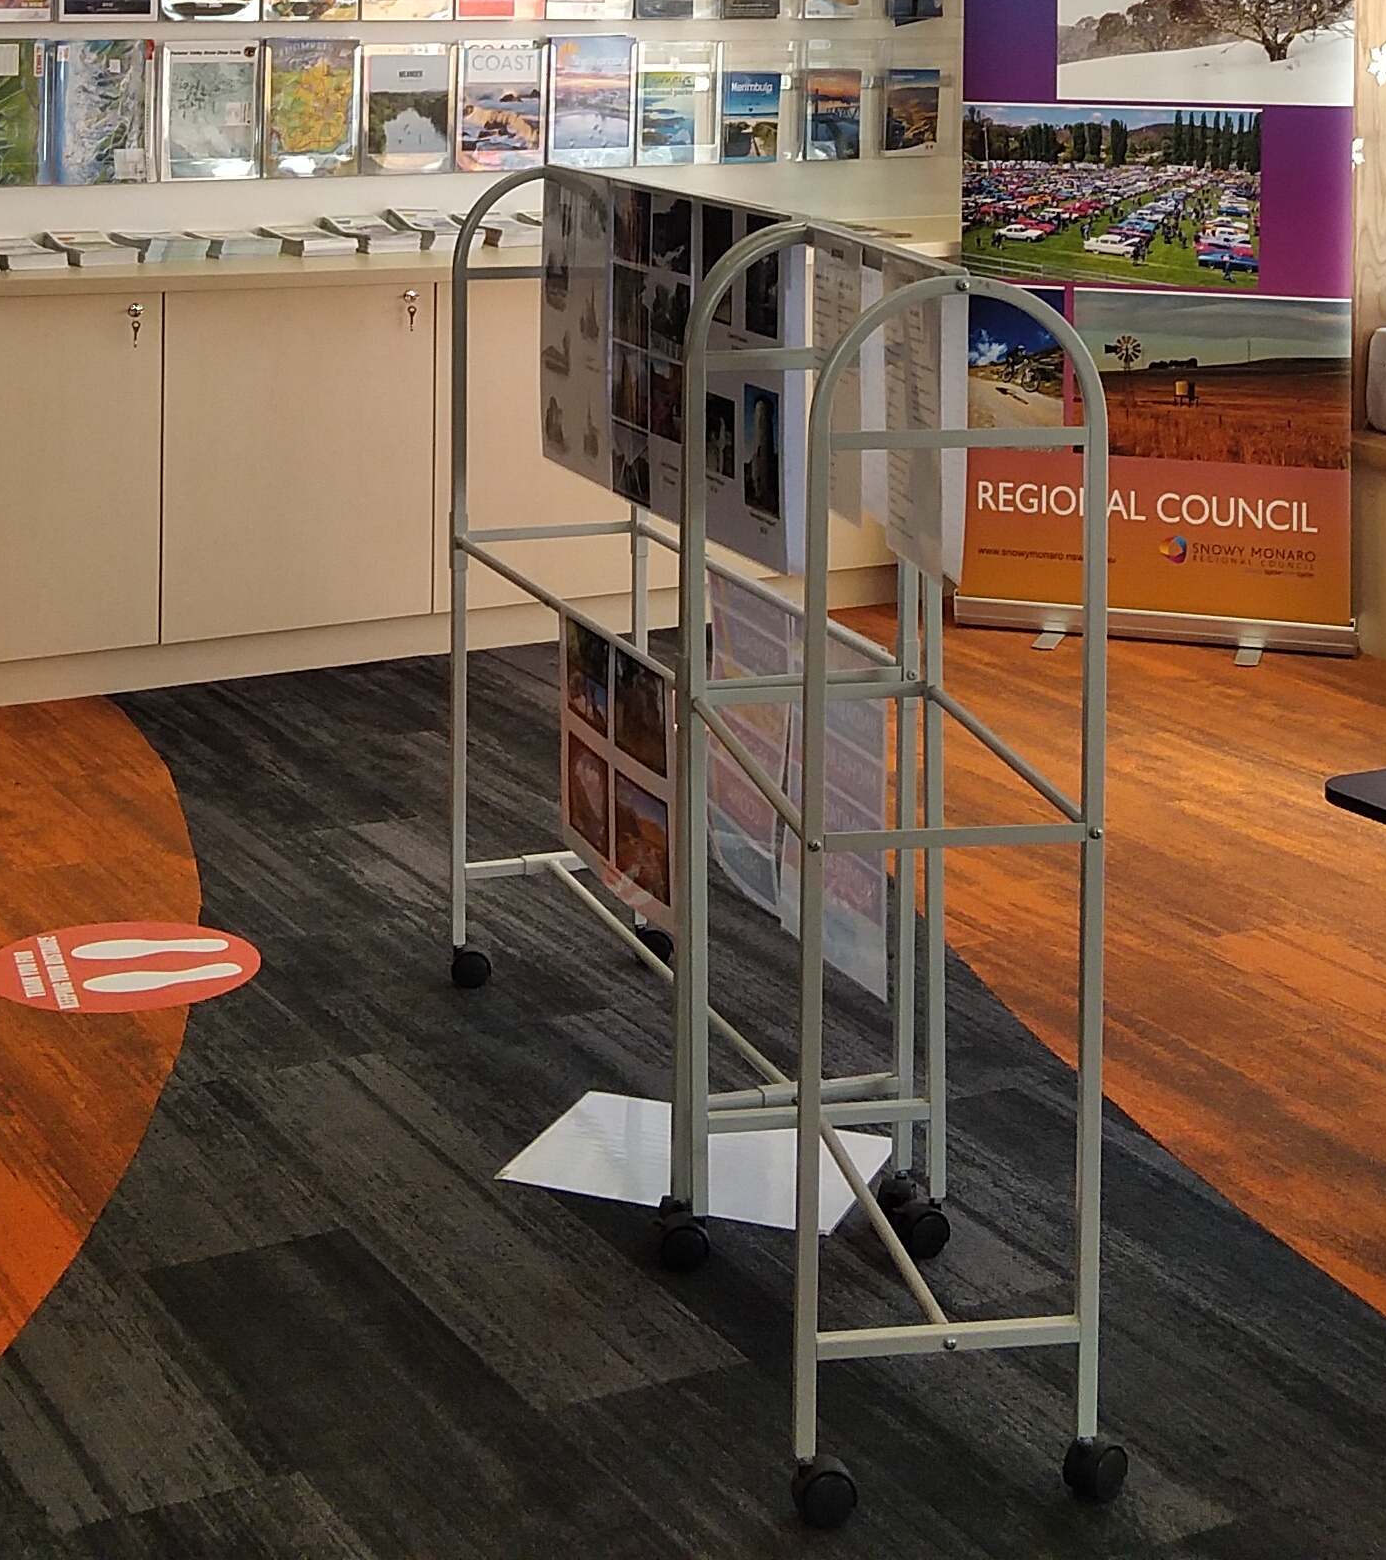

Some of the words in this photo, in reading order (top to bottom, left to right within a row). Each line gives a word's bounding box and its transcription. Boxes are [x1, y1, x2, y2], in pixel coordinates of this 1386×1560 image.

[472, 54, 534, 71] COAST
[398, 70, 423, 78] MEANDER
[1156, 493, 1318, 533] COUNCIL
[1192, 542, 1245, 557] SNOWY
[1250, 546, 1316, 562] MONARO
